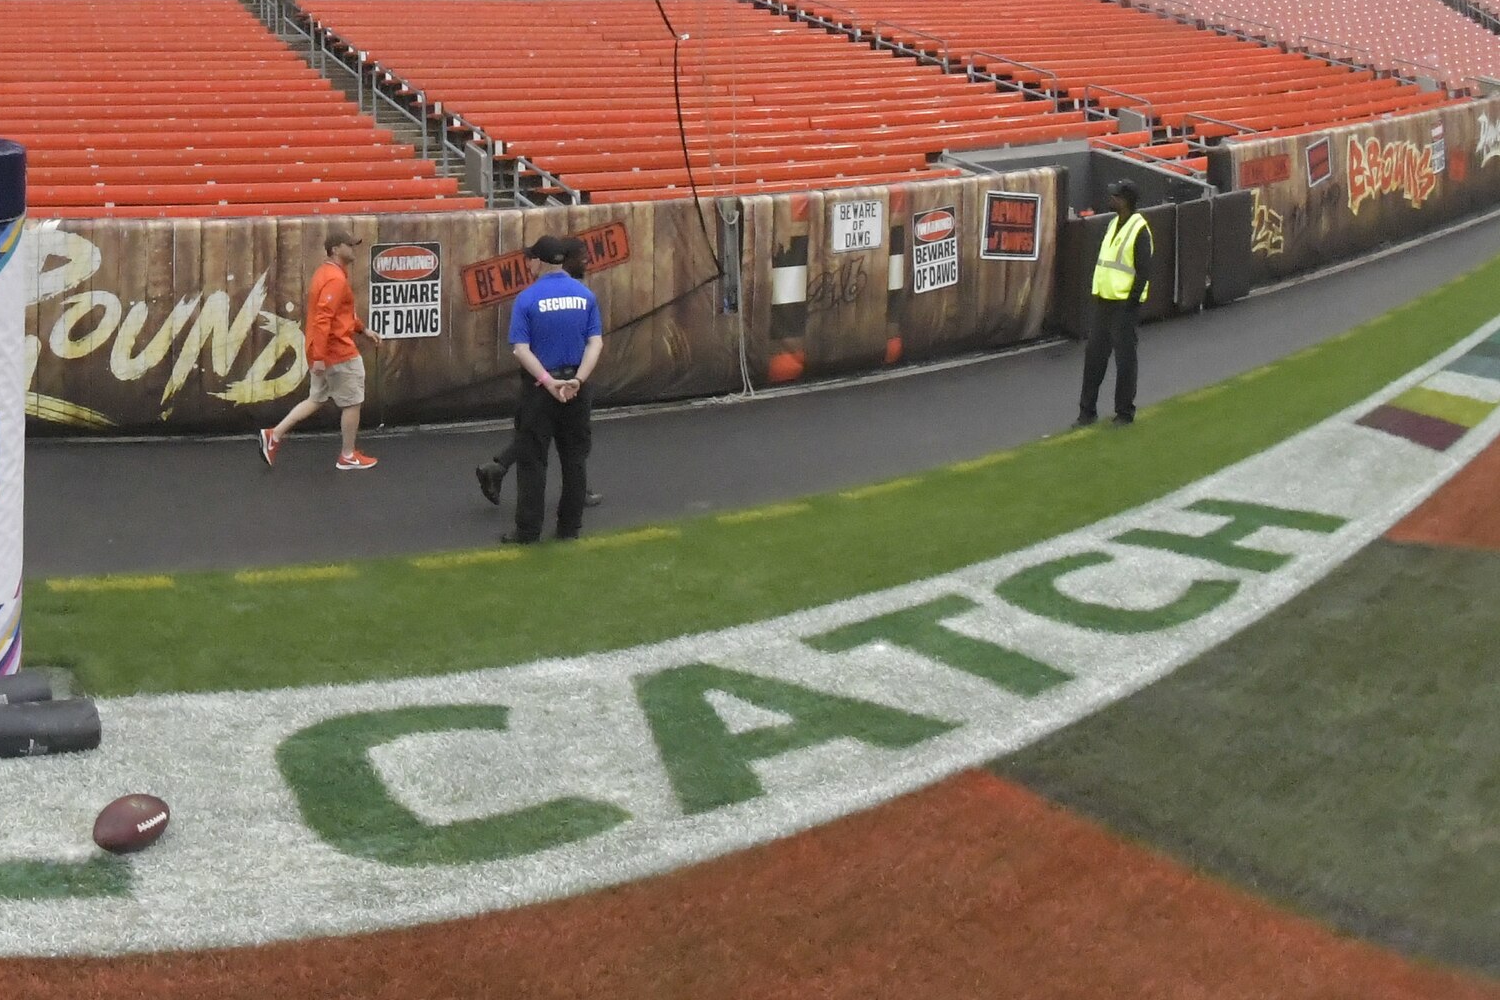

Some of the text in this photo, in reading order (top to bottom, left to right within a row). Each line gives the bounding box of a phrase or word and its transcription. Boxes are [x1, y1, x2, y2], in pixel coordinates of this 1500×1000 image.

[1347, 134, 1436, 216] BROWNS
[840, 202, 877, 220] BEWARE
[852, 220, 864, 231] OF
[845, 231, 871, 248] DAWG
[915, 240, 956, 264] BEWARE
[474, 256, 534, 300] BEWA
[916, 261, 956, 290] OF DAWG
[372, 283, 439, 305] BEWARE
[538, 296, 587, 313] SECURITY
[371, 308, 439, 335] OF DAWG
[276, 497, 1352, 868] CATCH
